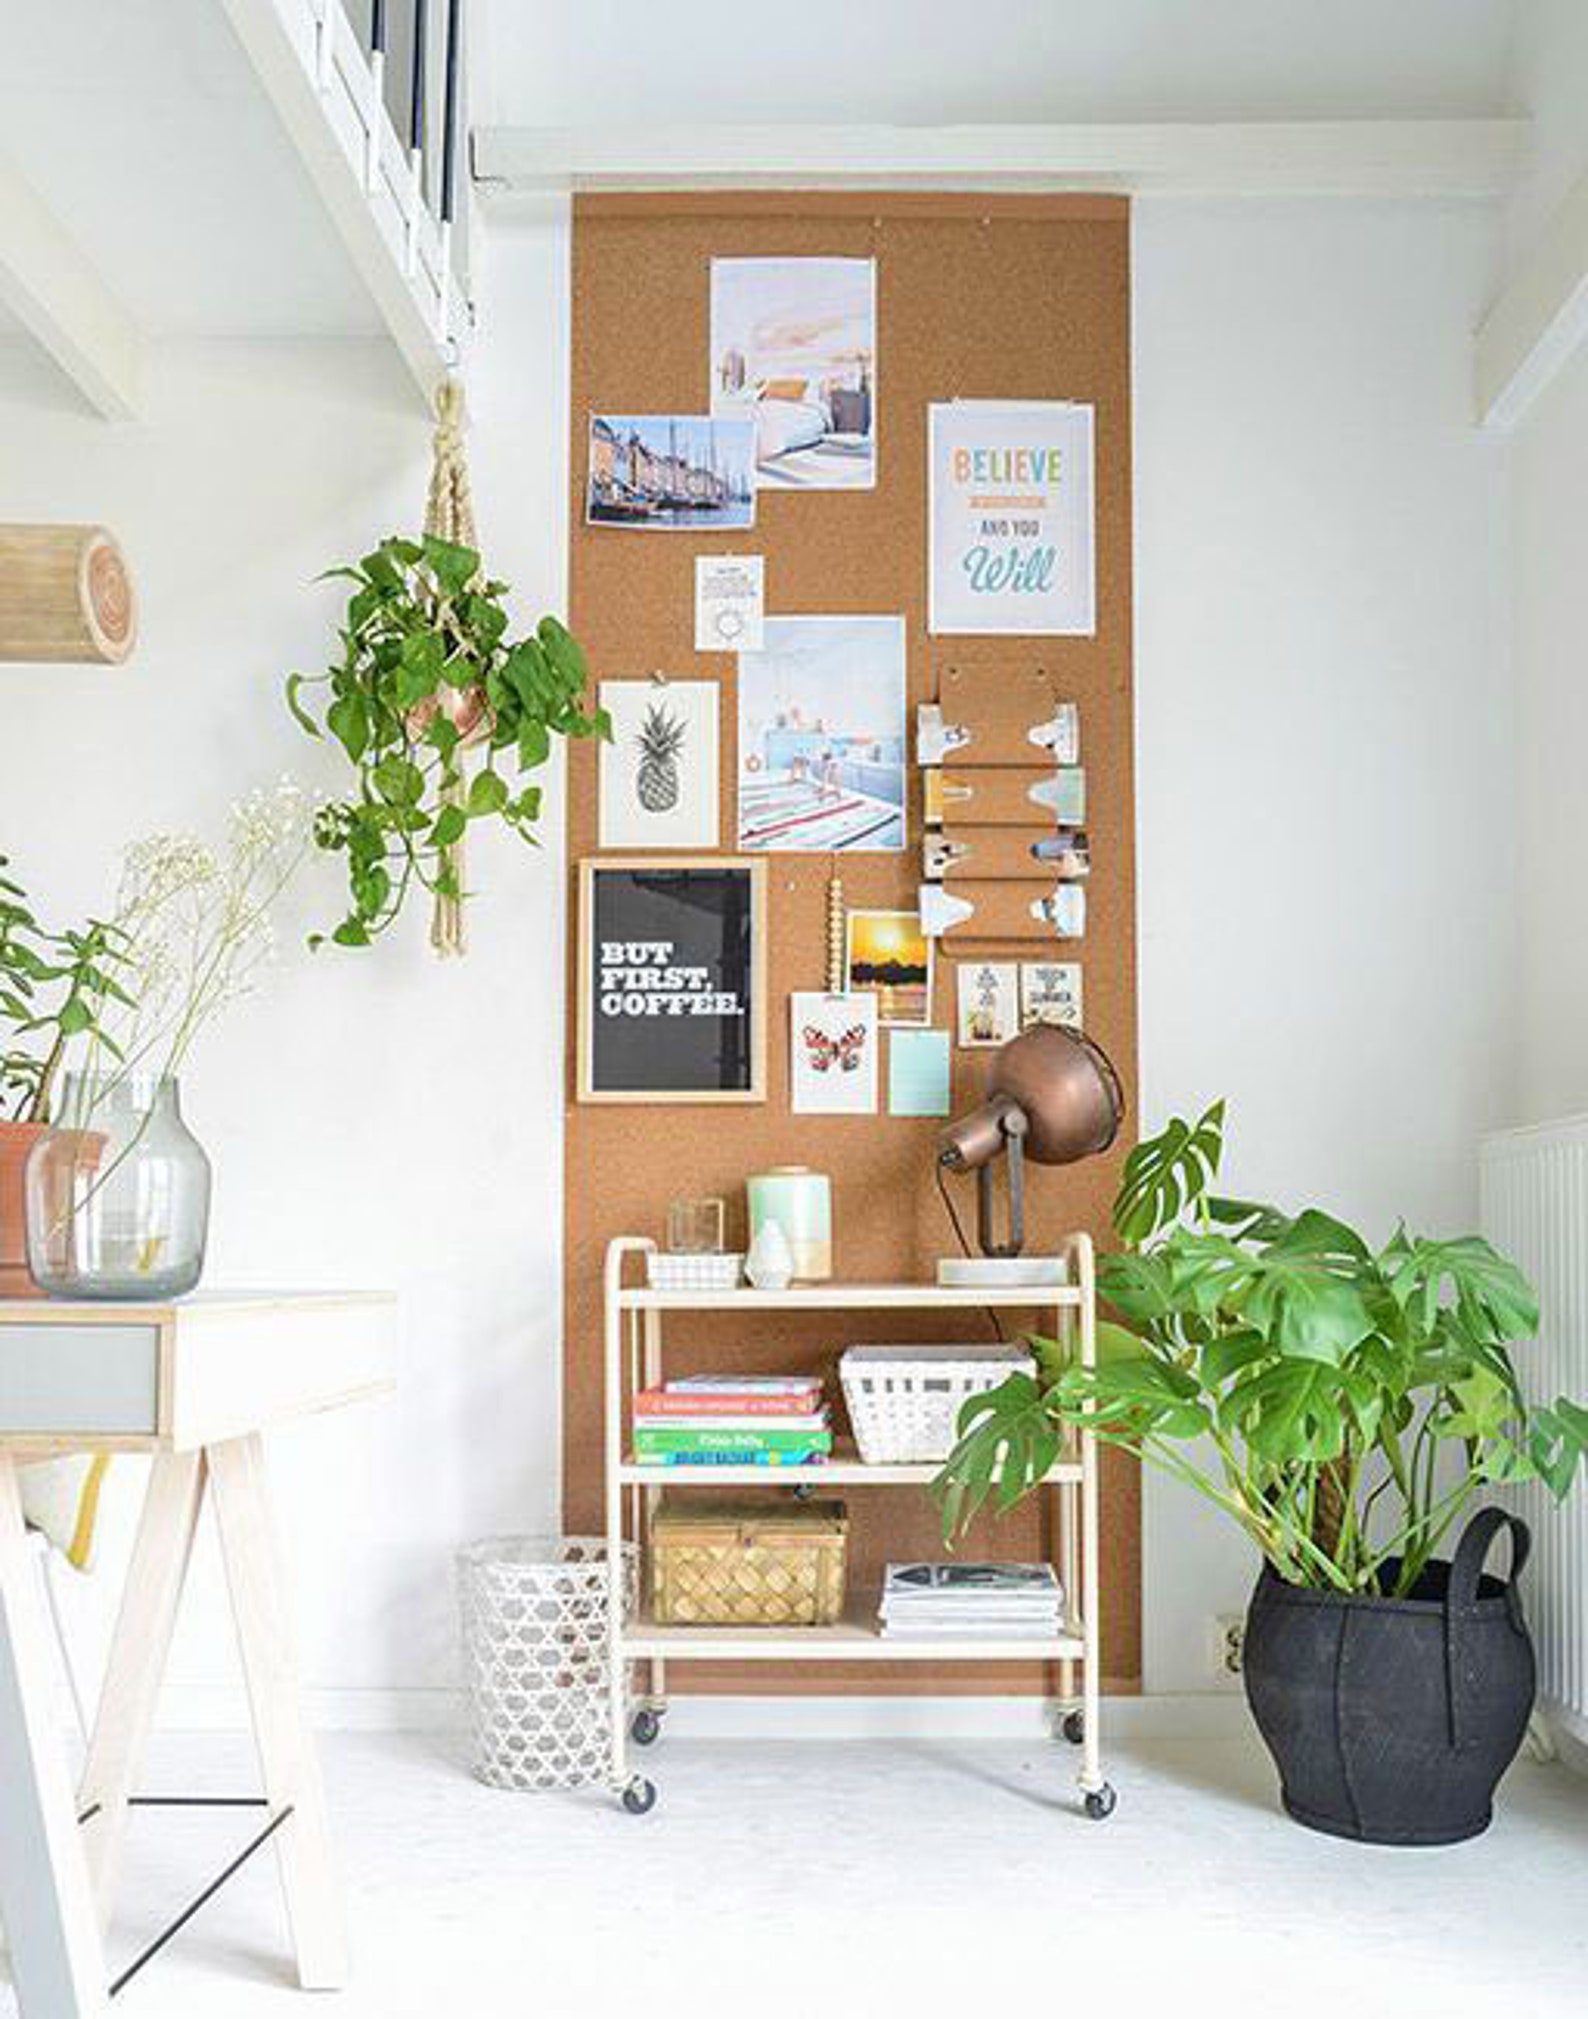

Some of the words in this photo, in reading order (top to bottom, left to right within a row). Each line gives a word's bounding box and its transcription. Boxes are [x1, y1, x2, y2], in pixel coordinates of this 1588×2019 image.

[954, 446, 1062, 483] BELIEVE
[980, 520, 1009, 537] AND
[1013, 520, 1040, 537] YOU
[963, 545, 1057, 593] Will
[600, 941, 674, 965] BUT
[600, 966, 714, 993] FIRST,
[600, 991, 745, 1016] COFFEE.
